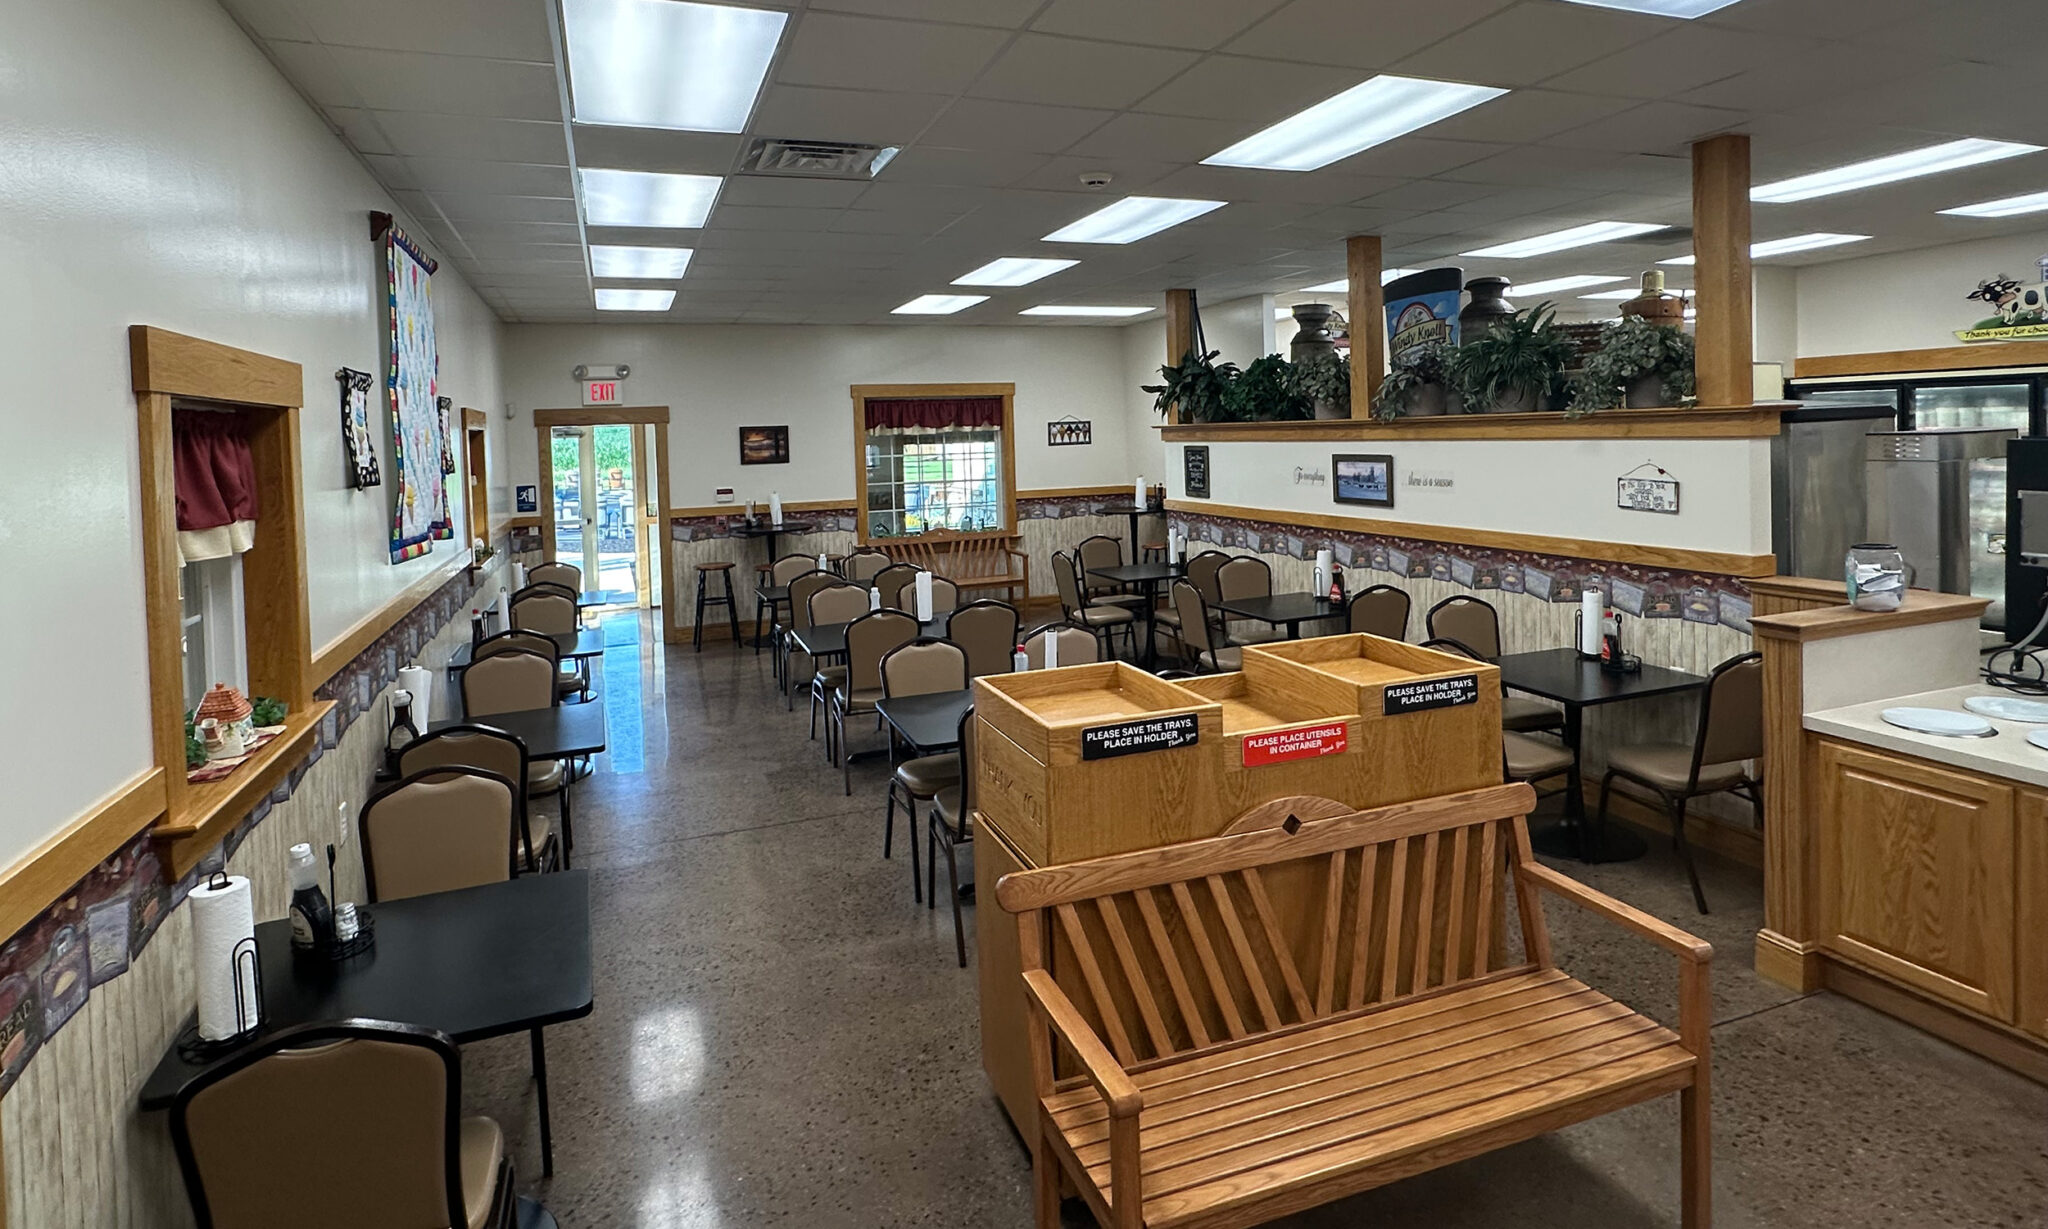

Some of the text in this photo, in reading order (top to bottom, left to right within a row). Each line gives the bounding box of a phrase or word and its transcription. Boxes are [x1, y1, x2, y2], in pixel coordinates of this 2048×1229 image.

[1390, 323, 1442, 354] Windy Knoll
[591, 383, 615, 401] EXIT
[1387, 687, 1415, 698] PLEASE
[1416, 685, 1434, 694] SAVE
[1435, 682, 1449, 691] THE
[1401, 689, 1462, 705] PLACE IN HOLDER
[1453, 695, 1466, 704] Thank
[1086, 719, 1194, 742] PLEASE SAVE THE TRAYS.
[1248, 727, 1342, 748] PLEASE PLACE UTENSILS
[1103, 730, 1178, 749] PLACE IN HOLDER
[1168, 732, 1197, 748] Thank You
[1269, 739, 1323, 755] IN CONTAINER
[1320, 744, 1335, 755] Thank
